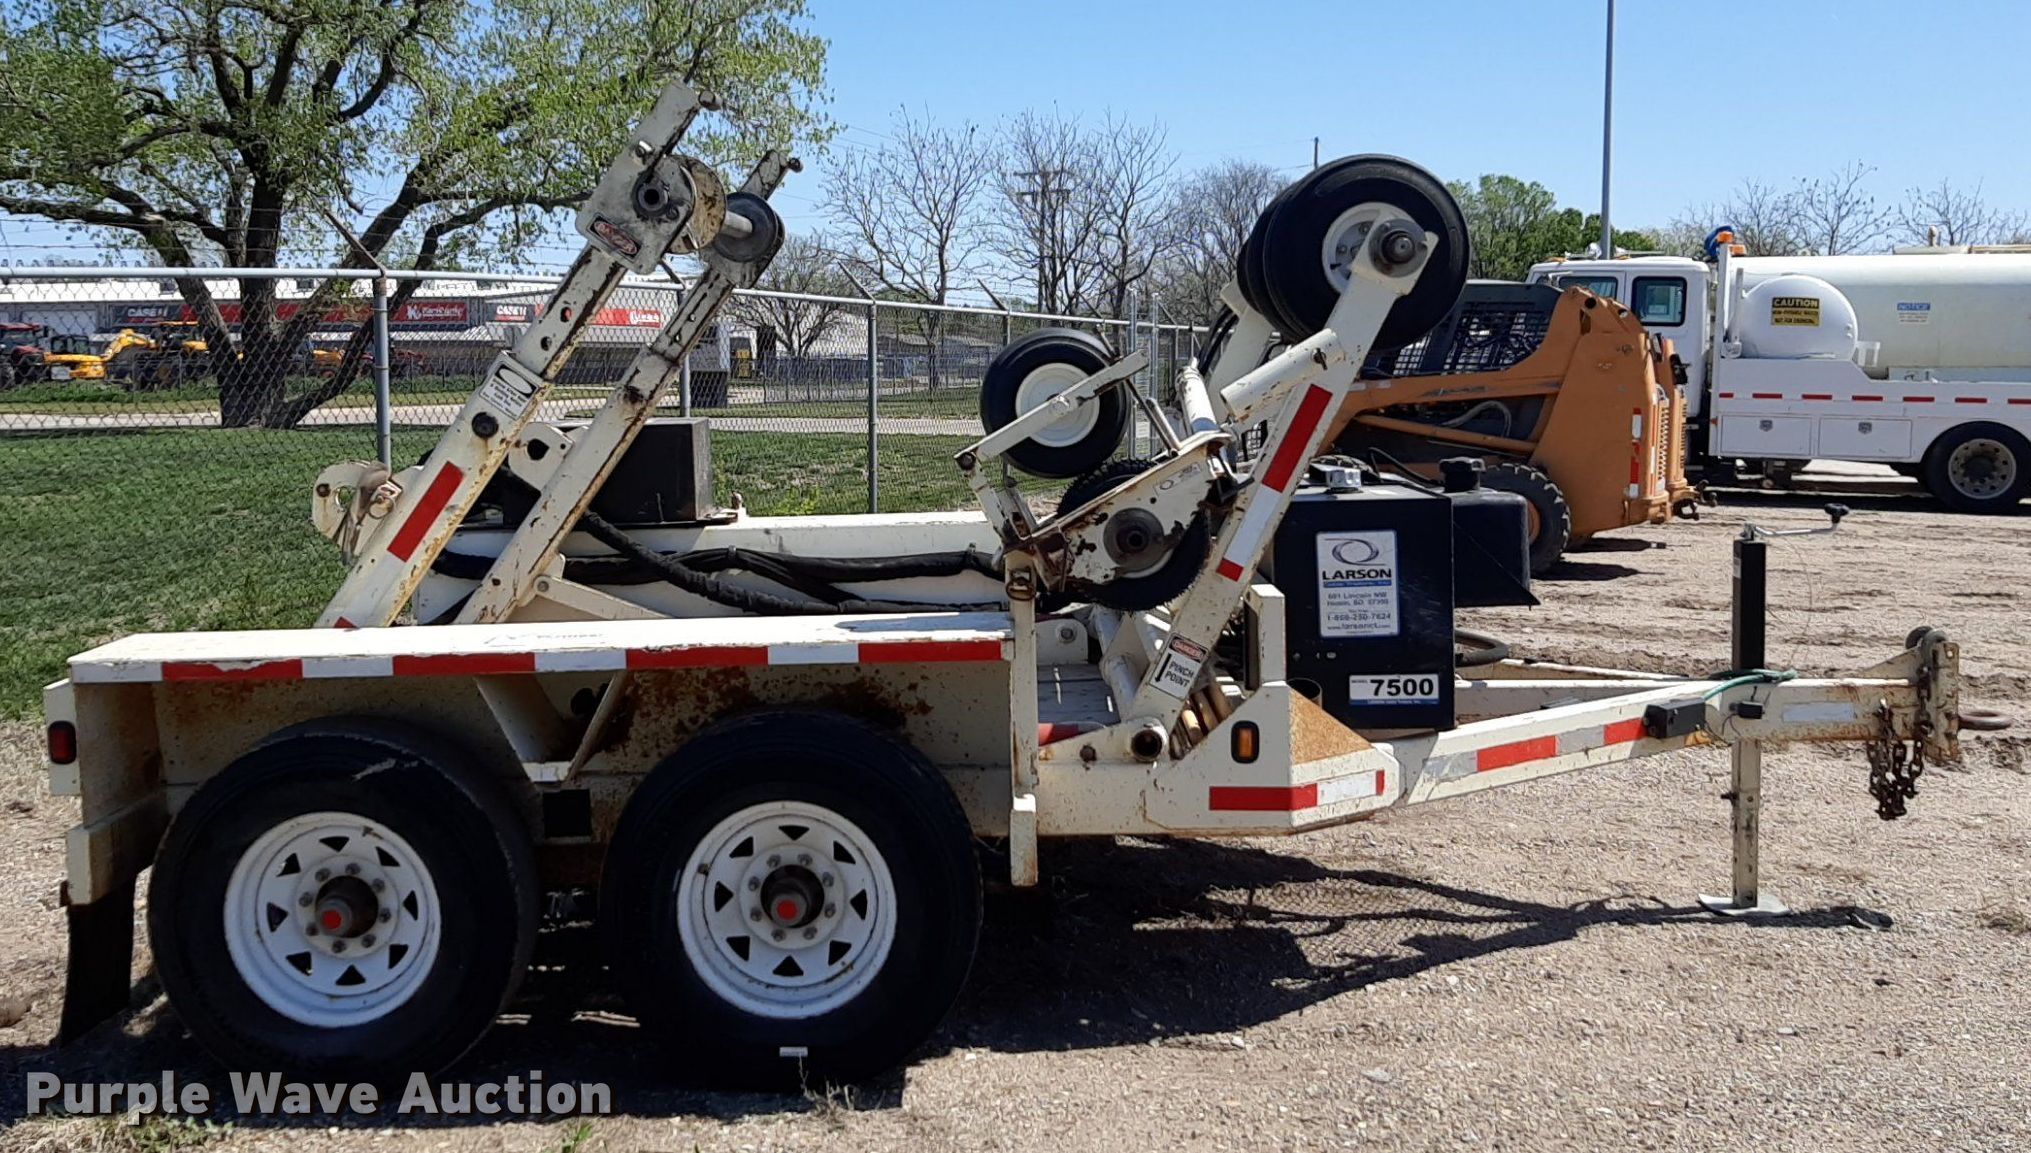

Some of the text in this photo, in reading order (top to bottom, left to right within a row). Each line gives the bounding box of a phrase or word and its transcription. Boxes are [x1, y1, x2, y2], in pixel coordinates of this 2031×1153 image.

[1774, 298, 1818, 307] CAUTION
[1322, 568, 1392, 580] LARSON
[1370, 678, 1434, 696] 7500
